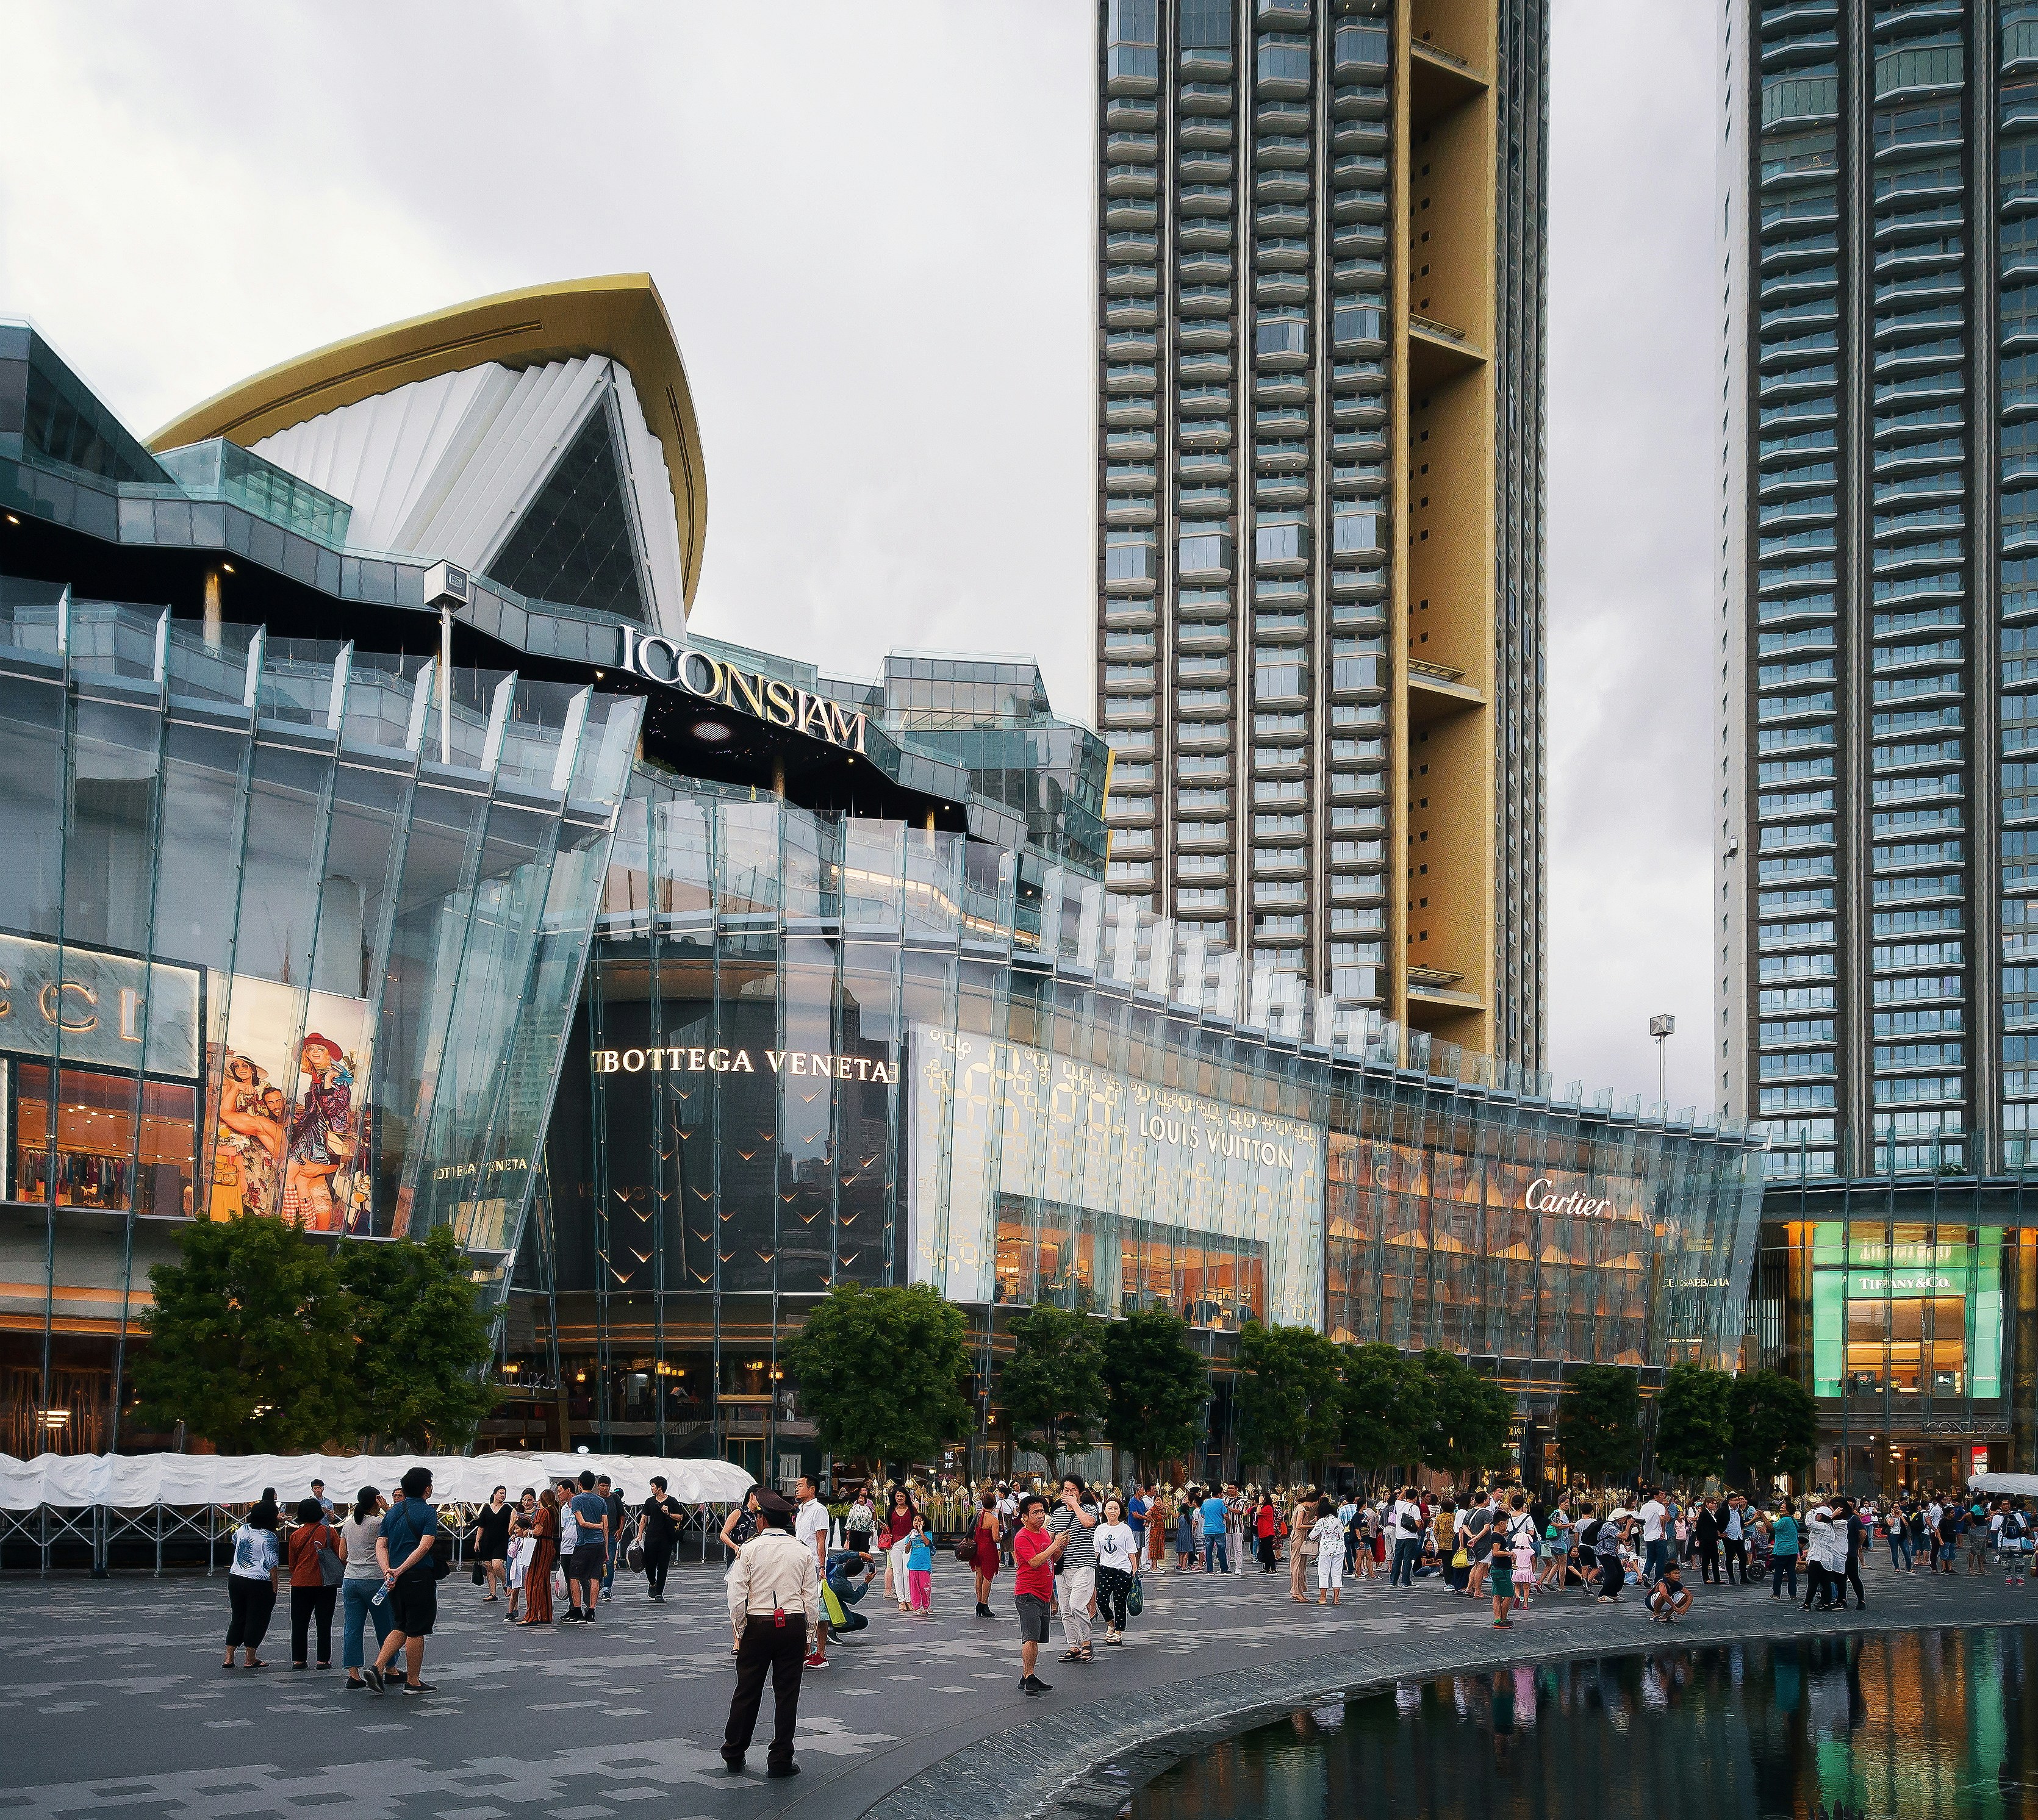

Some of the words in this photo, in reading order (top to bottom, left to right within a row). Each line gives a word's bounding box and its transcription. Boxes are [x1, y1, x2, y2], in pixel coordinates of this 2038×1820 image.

[619, 623, 869, 756] ICONSIAM
[0, 970, 143, 1042] CI
[603, 1048, 755, 1073] BOTTEGA
[765, 1050, 890, 1084] VENETA
[1139, 1112, 1200, 1149] LOUIS
[1205, 1128, 1293, 1170] VUITTON
[1525, 1178, 1612, 1217] Cartier
